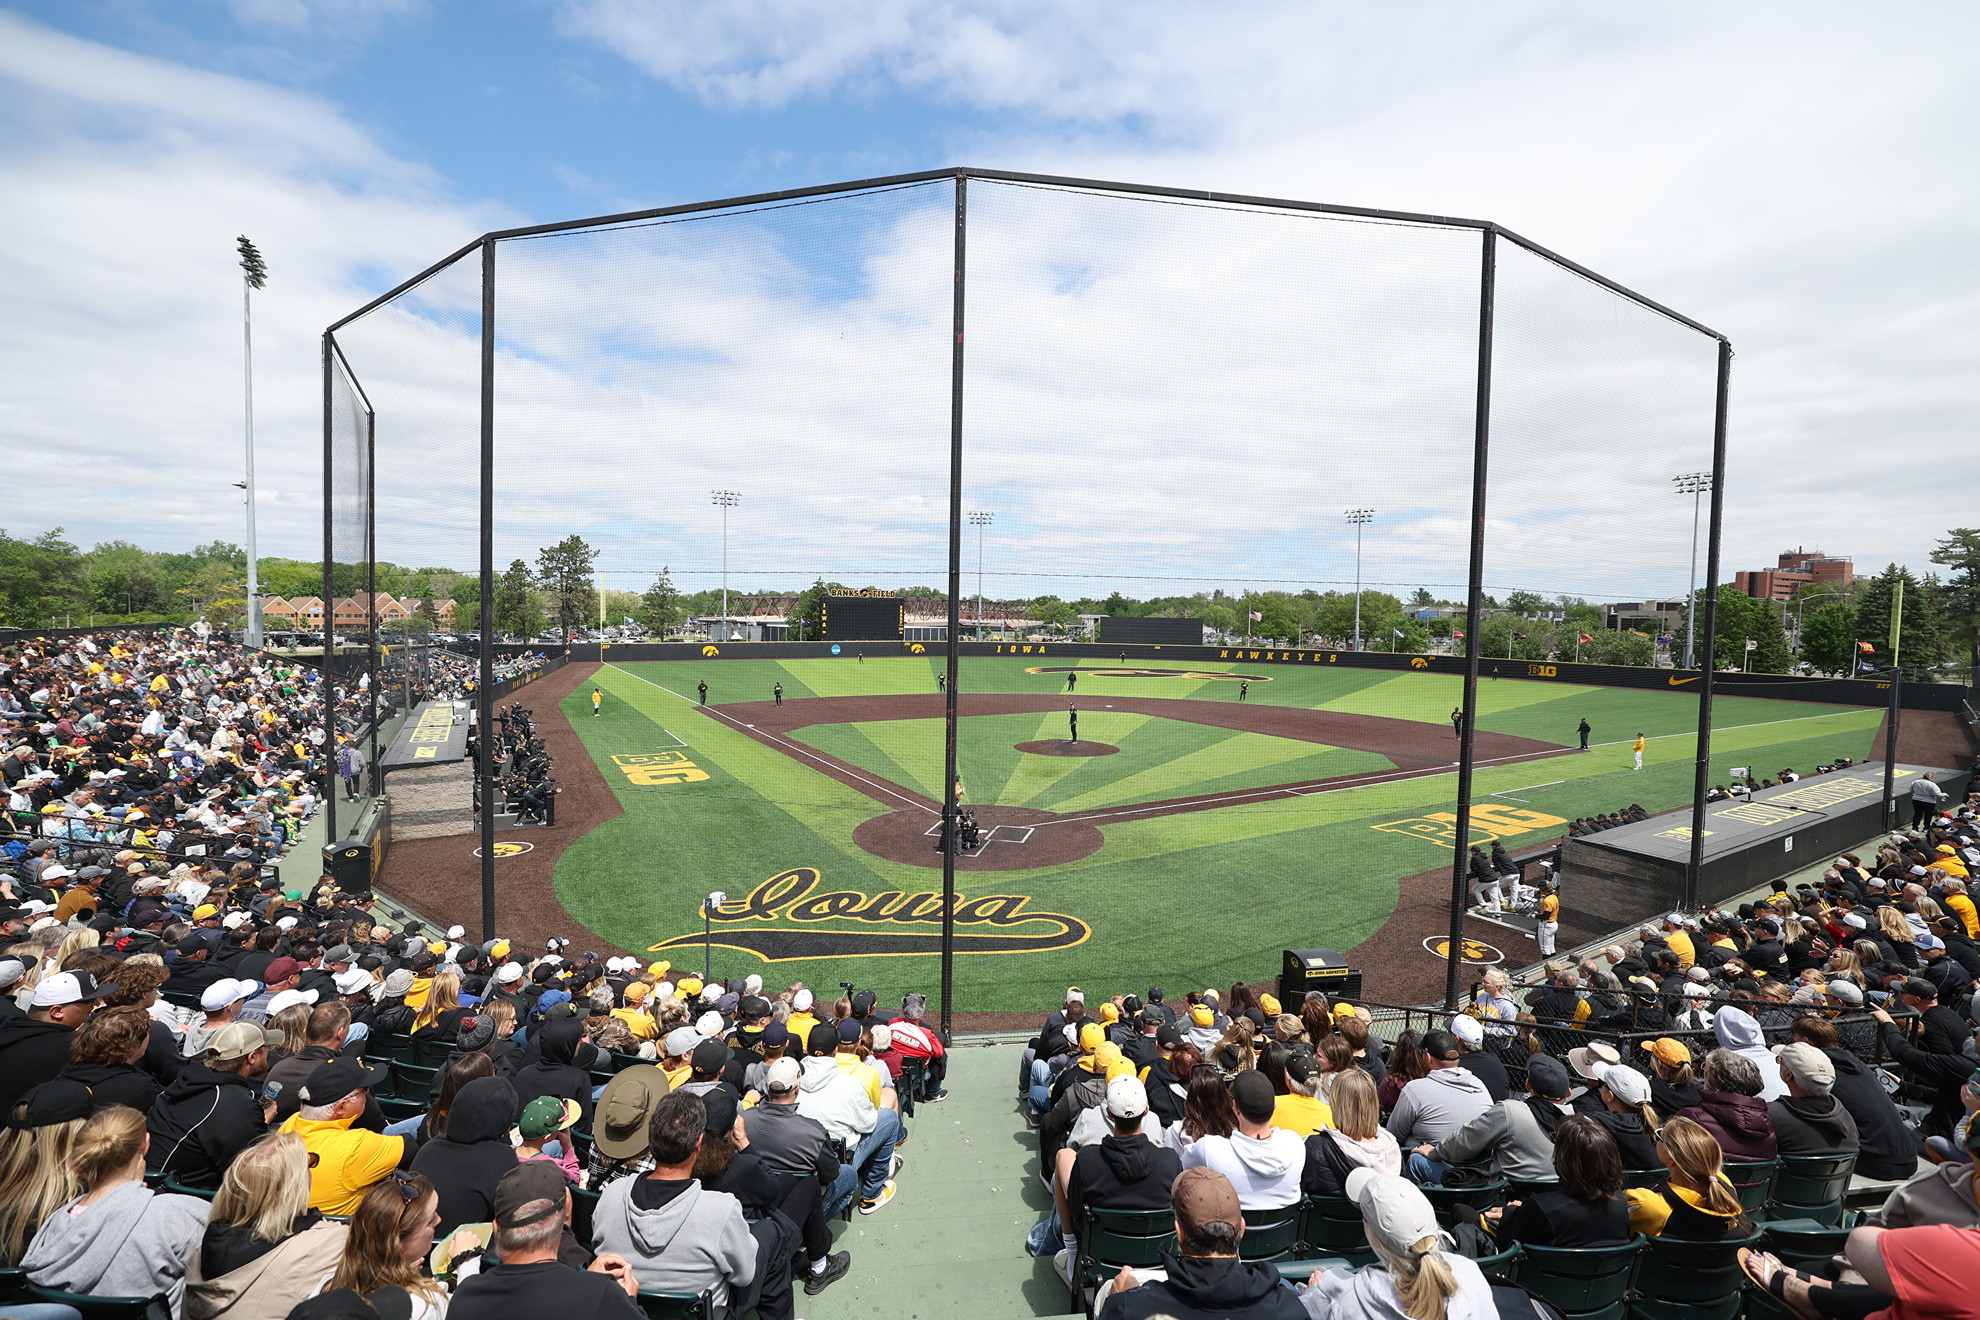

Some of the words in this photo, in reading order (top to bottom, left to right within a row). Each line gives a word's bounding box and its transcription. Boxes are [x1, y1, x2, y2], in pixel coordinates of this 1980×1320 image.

[831, 589, 859, 597] BANKS
[872, 590, 896, 598] FIELD
[996, 645, 1046, 653] IOWA
[1220, 650, 1337, 662] HAWKEYES
[892, 1030, 921, 1048] HOWARD
